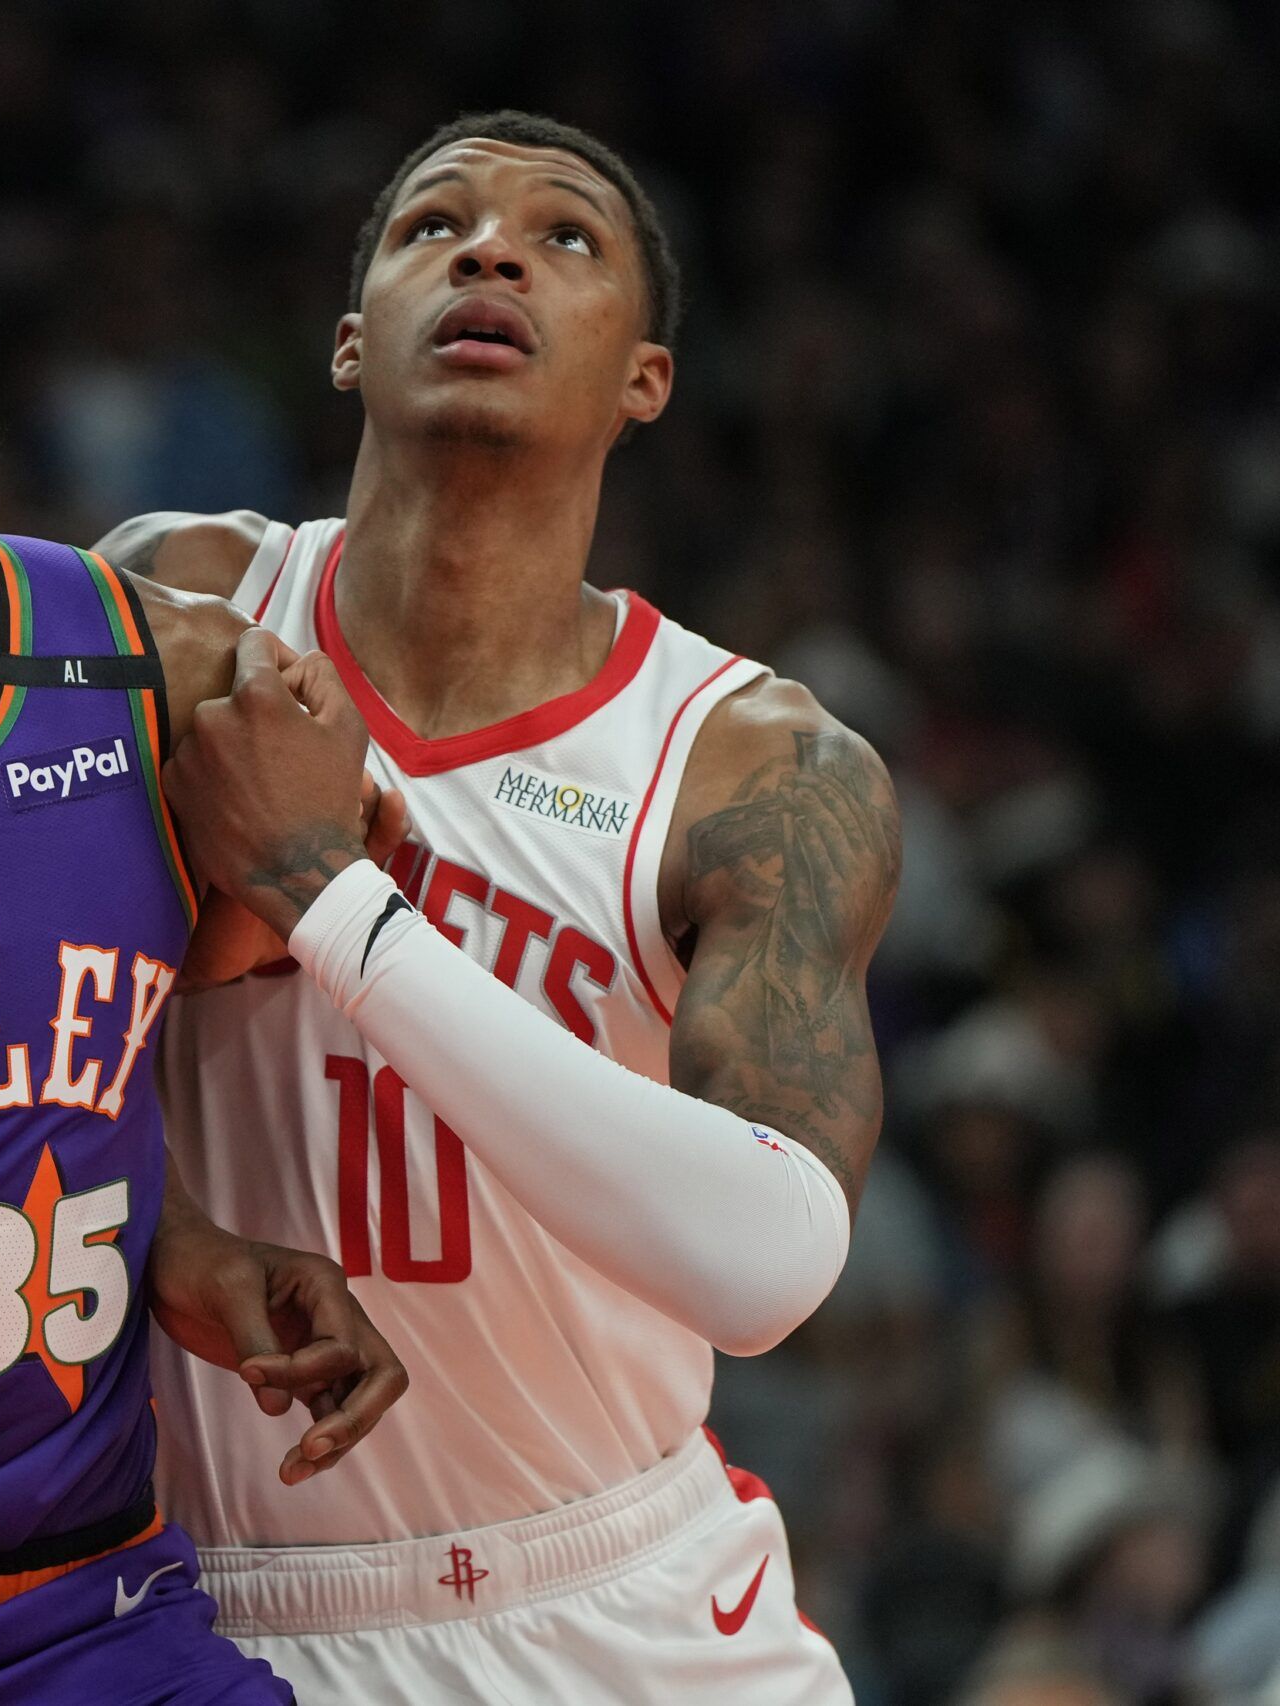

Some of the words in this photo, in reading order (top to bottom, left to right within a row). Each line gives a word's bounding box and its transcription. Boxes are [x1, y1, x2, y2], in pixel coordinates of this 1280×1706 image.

[64, 660, 88, 683] AL
[6, 738, 129, 798] PayPal
[499, 766, 629, 821] MEMORIAL
[494, 781, 627, 834] HERMANN
[384, 842, 619, 1047] ETS
[324, 1054, 472, 1284] 10
